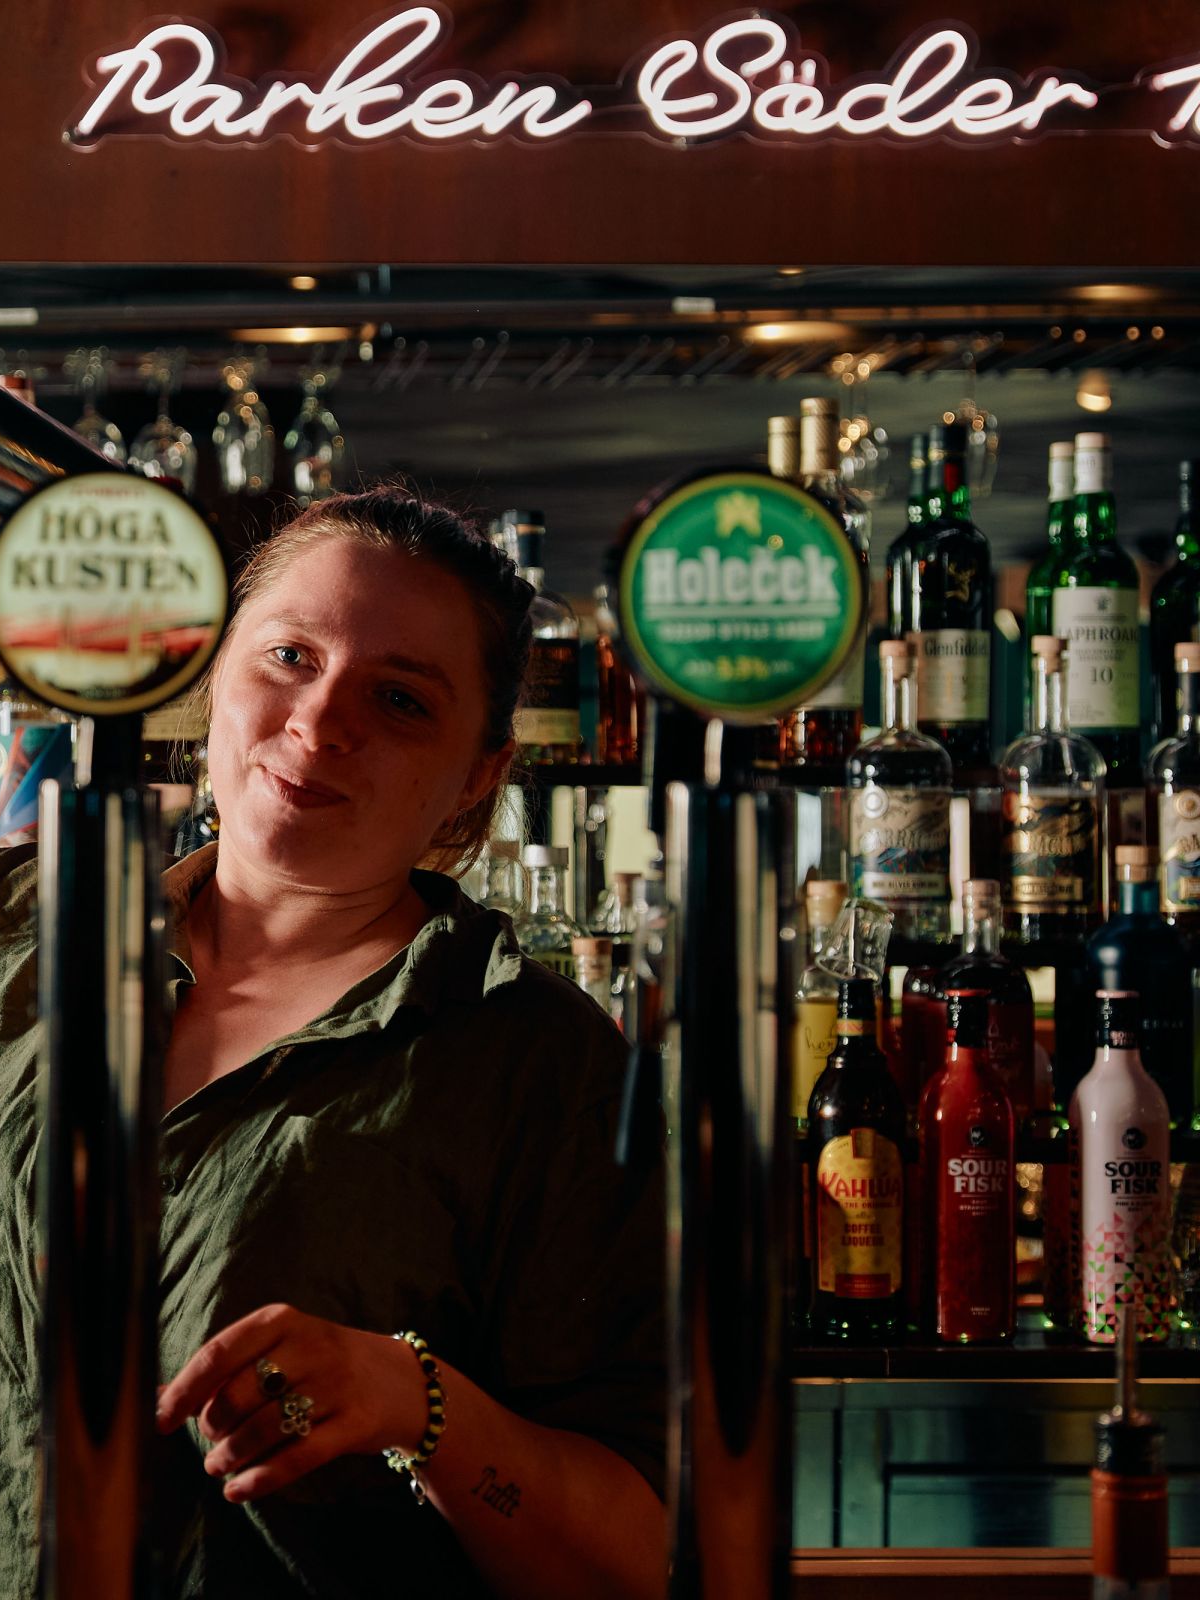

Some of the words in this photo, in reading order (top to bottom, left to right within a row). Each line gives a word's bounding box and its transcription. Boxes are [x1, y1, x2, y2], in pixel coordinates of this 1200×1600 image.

[76, 6, 593, 140] Parken
[10, 553, 200, 591] KUSTEN
[642, 544, 841, 605] Holeček
[1090, 665, 1114, 684] 10
[947, 1158, 1008, 1177] SOUR
[1104, 1161, 1163, 1178] SOUR
[953, 1176, 1005, 1194] FISK
[1111, 1178, 1160, 1195] FISK
